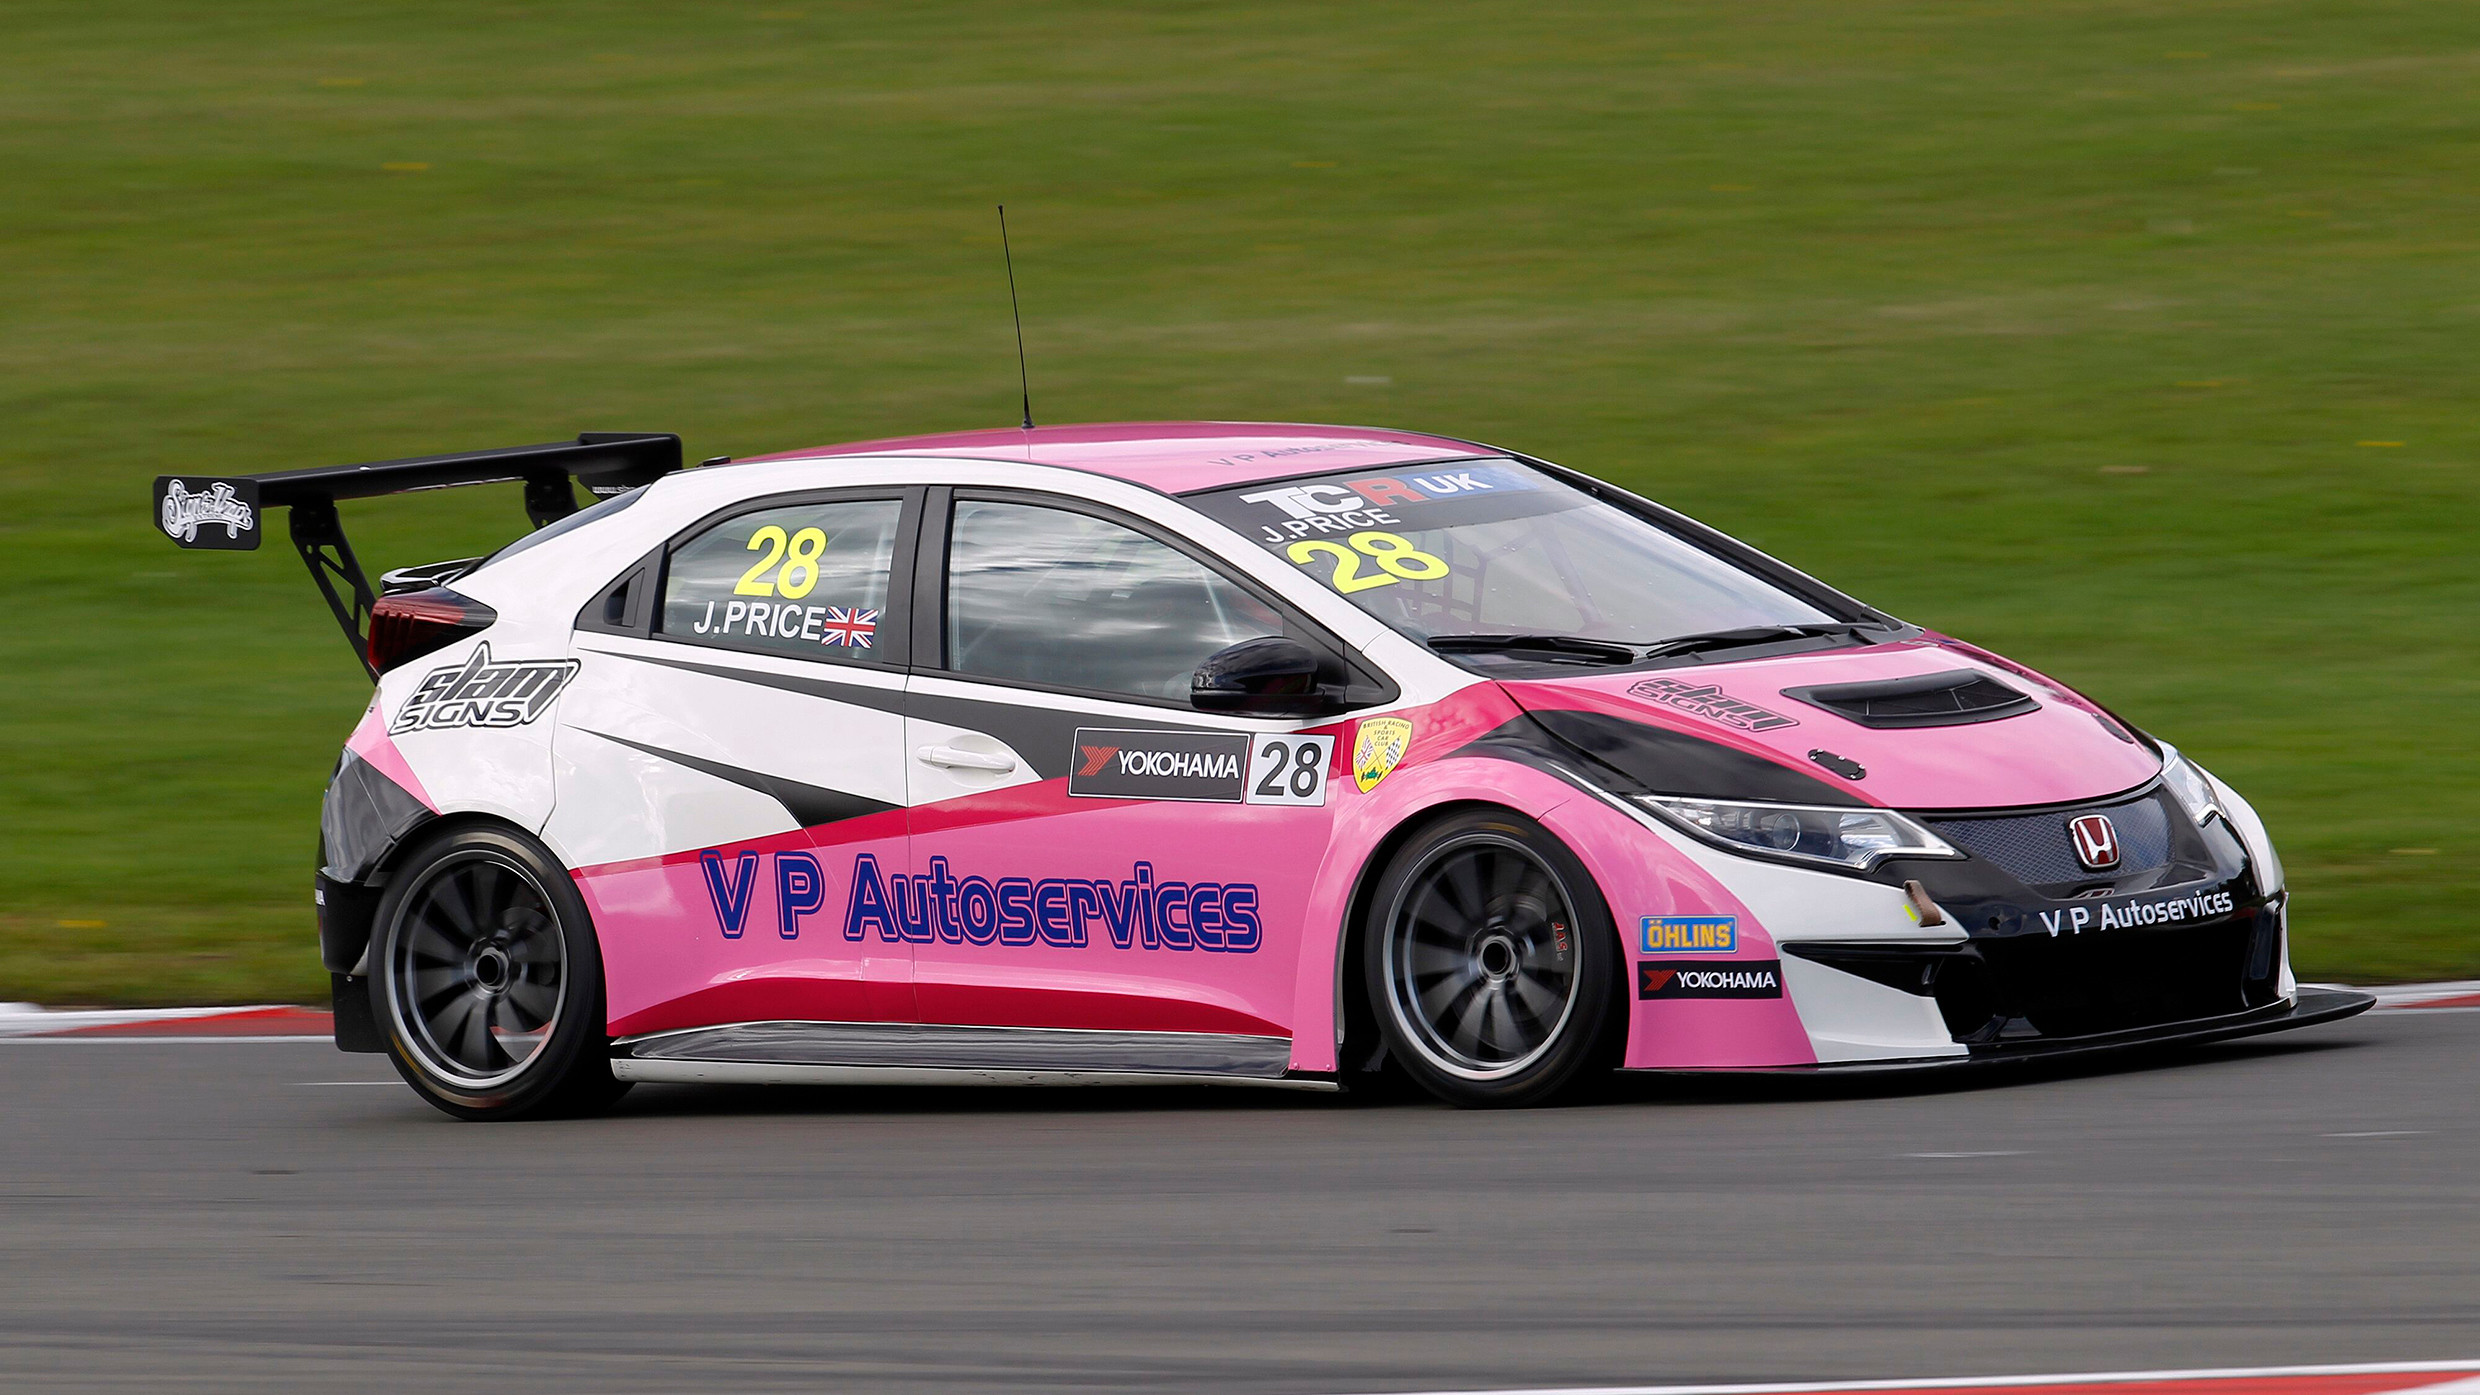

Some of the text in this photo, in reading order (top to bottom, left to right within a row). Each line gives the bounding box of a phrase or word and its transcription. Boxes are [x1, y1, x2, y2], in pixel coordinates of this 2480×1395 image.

[1238, 472, 1494, 520] TCR UK
[1261, 508, 1401, 544] J.PRICE
[733, 525, 828, 600] 28
[1286, 531, 1450, 595] 28
[693, 600, 827, 641] J.PRICE
[399, 700, 525, 726] SIGNS
[1363, 720, 1410, 730] BRITISH RACING
[1636, 684, 1750, 729] SIGNS
[1117, 749, 1240, 780] YOKOHAMA
[1255, 741, 1323, 798] 28
[700, 849, 1262, 954] V P Autoservices
[2039, 888, 2234, 938] V P Autoservices
[1648, 919, 1731, 948] ÖHLINS
[1676, 970, 1777, 989] YOKOHAMA
